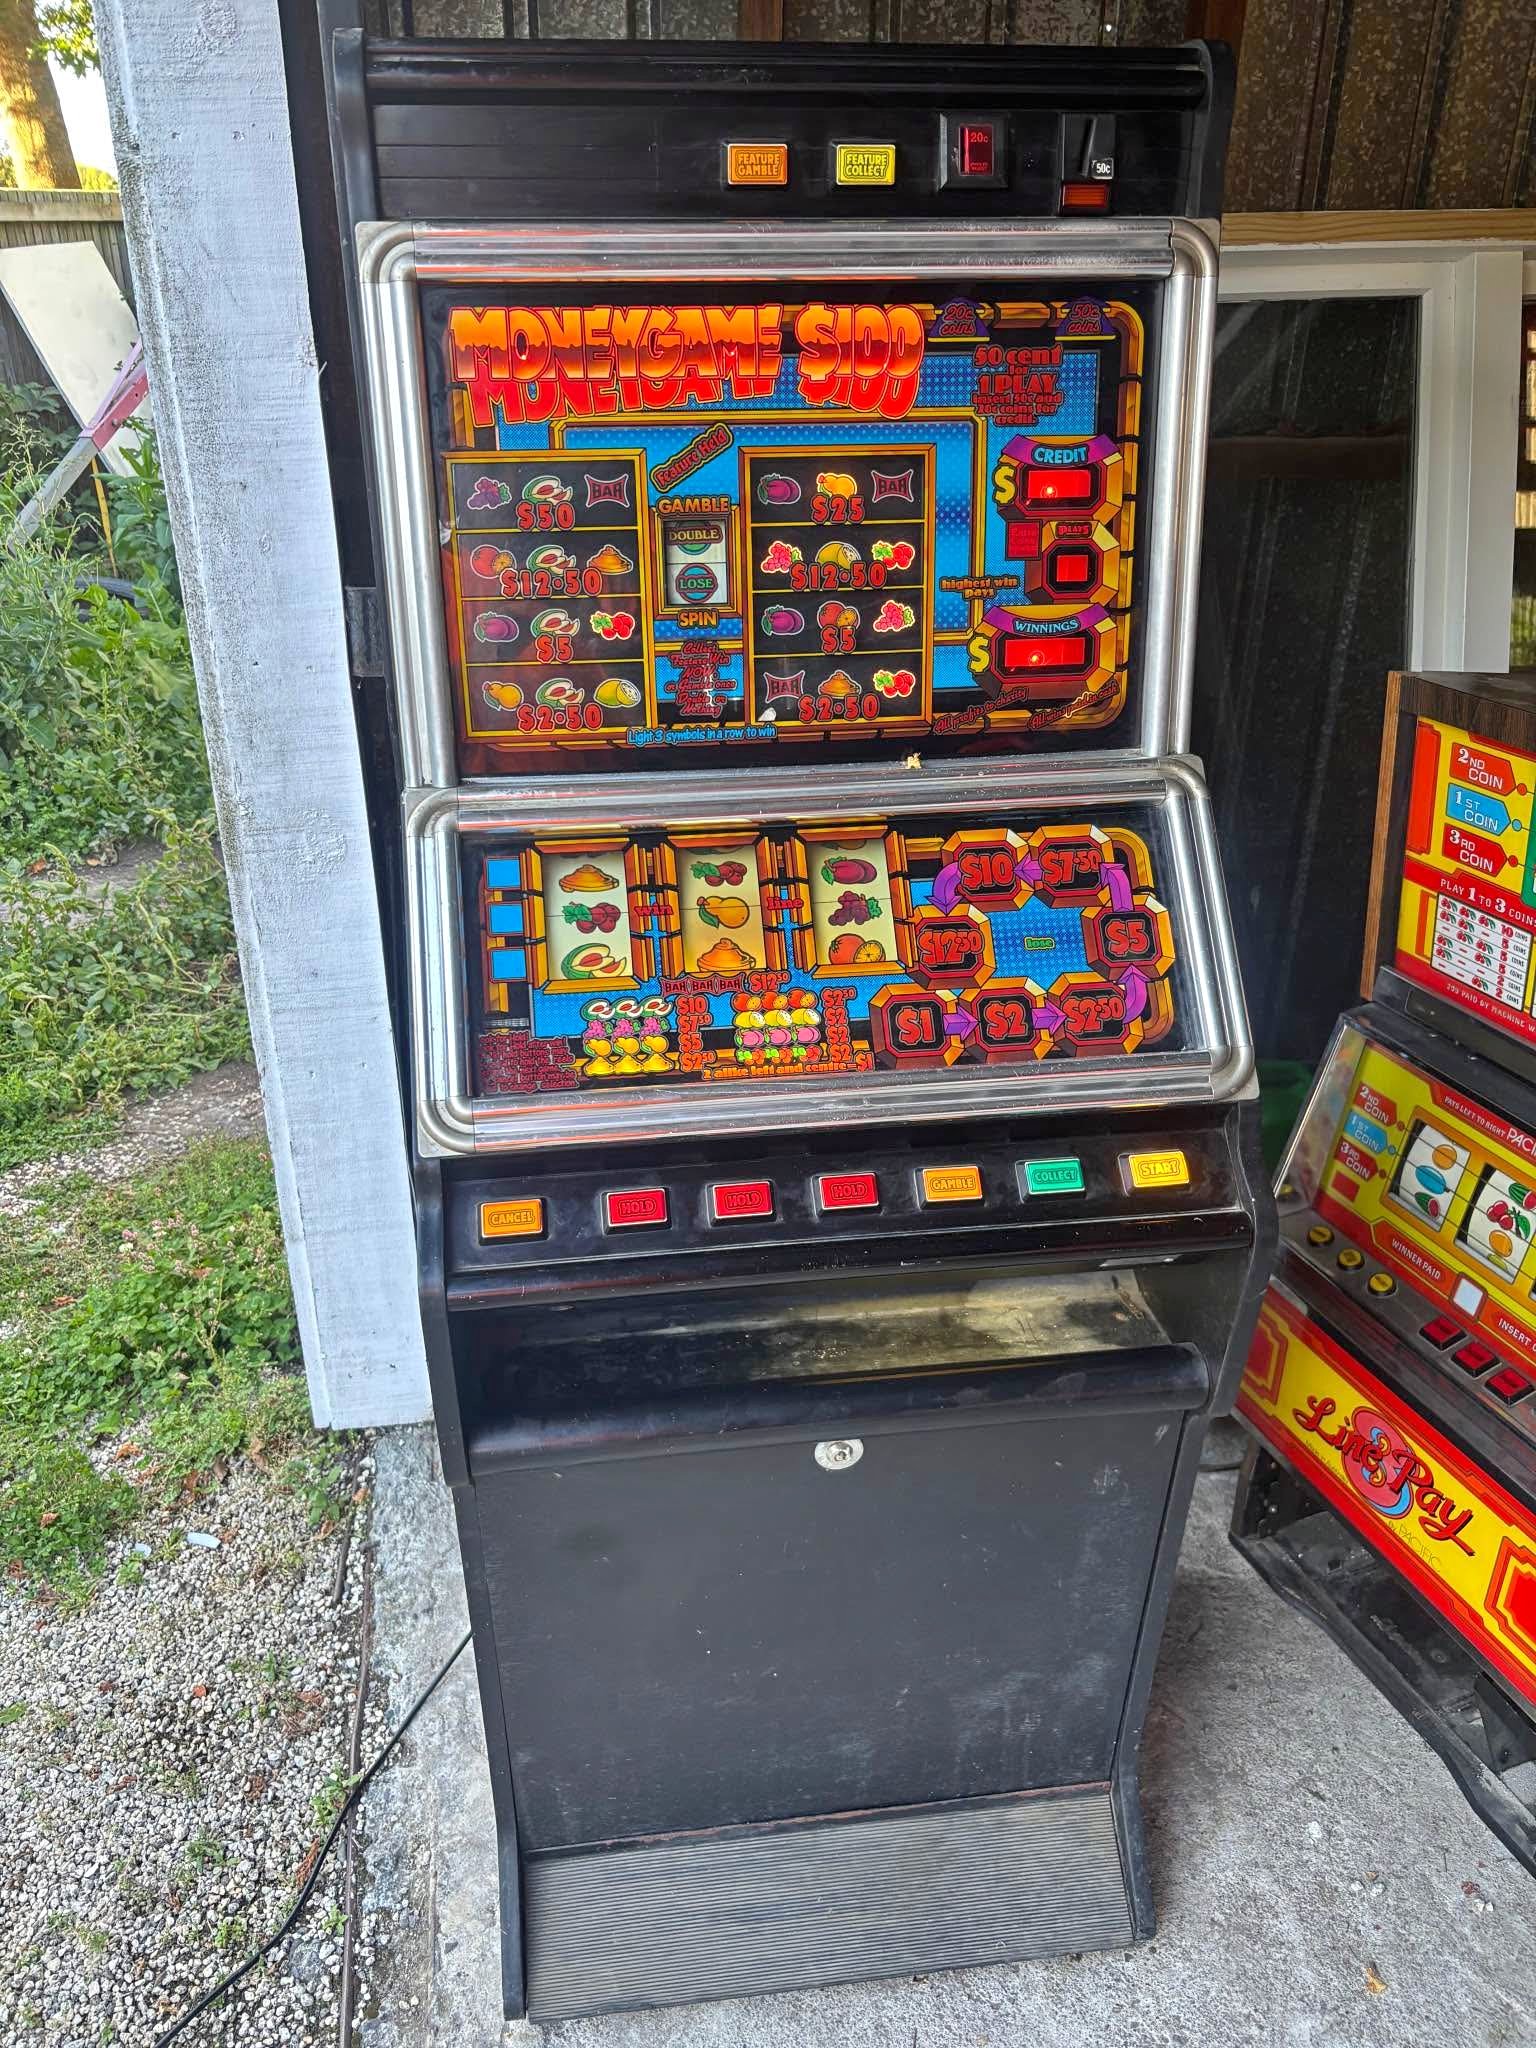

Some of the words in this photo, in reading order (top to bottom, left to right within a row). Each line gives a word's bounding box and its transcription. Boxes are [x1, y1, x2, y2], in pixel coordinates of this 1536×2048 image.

[970, 131, 989, 143] 20c
[738, 153, 780, 165] FEATURE
[847, 154, 887, 165] FEATURE
[738, 165, 778, 176] GAMBLE
[846, 165, 885, 176] COLLECT
[1096, 163, 1111, 174] 50c
[944, 304, 974, 320] 20c
[1071, 304, 1099, 320] 50c
[941, 321, 975, 335] coins
[1068, 321, 1101, 334] coins
[450, 304, 782, 382] MONEYGAME
[794, 303, 925, 382] $100
[975, 346, 1003, 366] 50
[1006, 344, 1062, 365] cent
[1009, 365, 1028, 374] for
[979, 374, 990, 393] 1
[994, 374, 1056, 393] PLAY
[1033, 447, 1087, 464] CREDIT
[655, 448, 699, 489] Feature
[994, 465, 1016, 504] $
[659, 499, 729, 514] GAMBLE
[811, 496, 865, 523] $25
[517, 502, 575, 531] $50
[669, 527, 719, 541] DOUBLE
[679, 578, 713, 590] LOSE
[941, 578, 991, 590] highest
[995, 577, 1018, 587] win
[678, 611, 718, 626] SPIN
[1015, 620, 1080, 634] WINNINGS
[683, 641, 716, 654] Collect
[821, 626, 856, 653] $5
[536, 635, 573, 663] $5
[969, 635, 990, 673] $
[683, 704, 720, 717] Nothing
[952, 706, 984, 729] profits
[995, 688, 1028, 708] charity
[628, 730, 654, 745] Light
[654, 731, 664, 742] 3
[666, 729, 706, 745] symbols
[707, 728, 716, 739] in
[716, 730, 723, 739] a
[725, 729, 744, 738] row
[746, 728, 757, 738] to
[758, 726, 776, 738] win
[1458, 747, 1485, 770] 2ND
[1468, 767, 1503, 790] COIN
[1455, 791, 1480, 810] 1ST
[1465, 809, 1498, 832] COIN
[1450, 829, 1476, 852] 3RD
[1459, 848, 1494, 872] COIN
[959, 854, 1014, 889] $10
[768, 896, 804, 910] line
[1440, 878, 1465, 896] PLAY
[1467, 887, 1477, 902] 1
[1478, 895, 1492, 908] TO
[1495, 898, 1507, 913] 3
[635, 901, 673, 916] win
[1026, 937, 1054, 949] lose
[1104, 920, 1148, 956] $5
[1514, 928, 1528, 942] COINS
[1513, 942, 1526, 956] COINS
[1511, 954, 1524, 967] COINS
[1509, 967, 1523, 980] COINS
[1508, 980, 1521, 993] COINS
[677, 996, 706, 1015] $10
[1506, 992, 1519, 1005] COINS
[824, 1007, 847, 1025] $2
[1462, 990, 1478, 1004] PAID
[1480, 999, 1489, 1009] BY
[1491, 1006, 1526, 1028] MACHINE
[897, 1007, 933, 1044] $1
[985, 1004, 1026, 1039] $2
[680, 1034, 702, 1052] $5
[827, 1026, 849, 1043] $2
[830, 1044, 852, 1063] $2
[714, 1066, 749, 1078] alike
[751, 1064, 775, 1076] left
[776, 1062, 803, 1074] and
[1364, 1102, 1389, 1124] COIN
[1444, 1096, 1459, 1111] PAYS
[1459, 1104, 1476, 1120] LEFT
[1476, 1115, 1485, 1127] TO
[1485, 1120, 1506, 1139] RIGHT
[1507, 1127, 1536, 1157] PACI
[1355, 1129, 1379, 1151] COIN
[1035, 1170, 1076, 1182] COLLECT
[1142, 1162, 1178, 1176] START
[1345, 1156, 1370, 1179] COIN
[833, 1184, 865, 1198] HOLD
[933, 1177, 973, 1190] GAMBLE
[621, 1201, 653, 1215] HOLD
[727, 1193, 760, 1207] HOLD
[491, 1212, 534, 1224] CANCEL
[1391, 1238, 1423, 1269] WINNER
[1423, 1261, 1441, 1280] PAID
[1498, 1317, 1532, 1347] INSERT
[1292, 1395, 1384, 1473] Line
[1387, 1448, 1476, 1557] Pay
